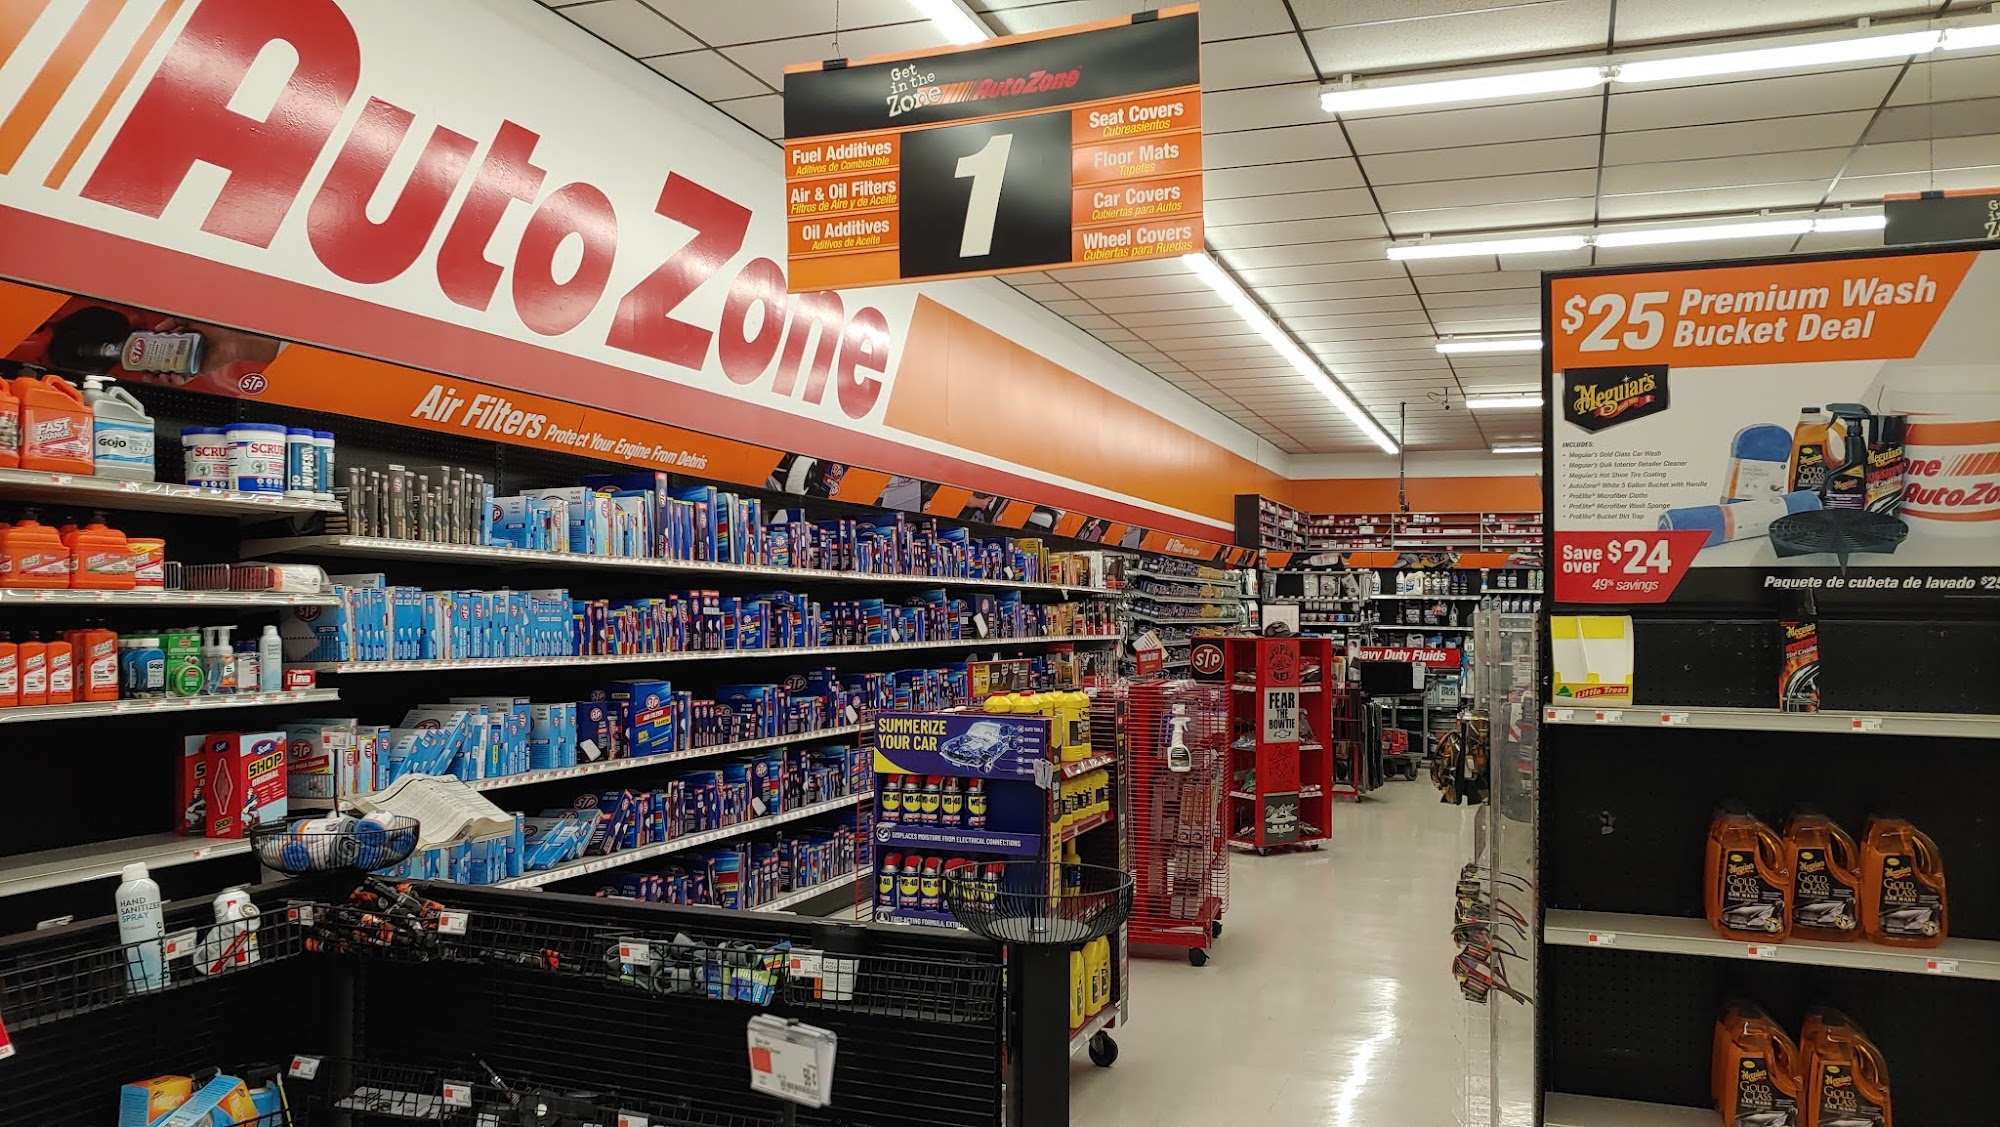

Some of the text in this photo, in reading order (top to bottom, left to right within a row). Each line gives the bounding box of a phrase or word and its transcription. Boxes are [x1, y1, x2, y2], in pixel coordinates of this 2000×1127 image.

[891, 63, 917, 81] Get
[890, 72, 935, 94] in the
[974, 69, 1080, 100] AutoZone
[886, 87, 942, 117] Zone
[1089, 102, 1184, 128] Seat Covers
[1103, 119, 1171, 138] Cubreasientos
[792, 141, 892, 165] Fuel Additives
[1094, 143, 1179, 168] Floor Mats
[796, 156, 890, 176] Aditivos de Combustible
[1119, 162, 1156, 176] Tapetes
[790, 180, 896, 204] Air & Oil Filters
[954, 134, 1013, 258] 1
[1093, 186, 1181, 209] Car Covers
[79, 0, 888, 419] AutoZone
[791, 193, 896, 214] Filtros de Aire y de Aceite
[1092, 201, 1182, 220] Cubiertas para Autos
[802, 219, 890, 241] Oil Additives
[812, 235, 881, 251] Aditivos de Aceite
[1082, 226, 1192, 250] Wheel Covers
[1083, 240, 1193, 261] Cubiertas para Ruedas
[1561, 274, 1937, 352] $25 Premium Wash
[1673, 310, 1876, 348] Bucket Deal
[241, 376, 264, 391] STP
[1573, 372, 1656, 417] Meguiar's
[38, 417, 71, 432] FAST
[410, 384, 708, 470] Air Filters Protect Your Engine From Debris
[99, 437, 127, 448] GOJO
[195, 446, 228, 457] SCRU
[1798, 465, 1824, 475] GOLD
[1901, 457, 1942, 477] one
[1643, 471, 1667, 479] Coating
[1801, 473, 1826, 481] CLASS
[1903, 482, 2000, 506] AutoZo
[1647, 502, 1671, 510] Sponge
[1563, 539, 1672, 575] Save $24
[1563, 561, 1600, 575] over
[1591, 578, 1659, 593] 49% savings
[1764, 576, 1823, 589] Paquete
[1826, 576, 1845, 589] de
[1848, 576, 1899, 589] cubeta
[1902, 576, 1922, 589] de
[1925, 576, 1976, 589] lavado
[1195, 648, 1220, 669] STP
[1360, 649, 1447, 662] eavy Duty Fluids
[292, 673, 311, 683] Lava
[787, 677, 804, 691] STP
[1576, 686, 1628, 698] Little Trees
[648, 696, 659, 709] STP
[1269, 692, 1295, 709] FEAR
[1276, 709, 1288, 719] THE
[878, 718, 947, 735] SUMMERIZE
[1269, 719, 1295, 730] BOWTIE
[293, 741, 311, 756] STP
[879, 734, 937, 751] YOUR CAR
[249, 752, 283, 778] SHOP
[252, 769, 280, 787] ORIGINAL
[576, 796, 596, 808] STP
[904, 795, 921, 803] WD-4
[943, 797, 961, 805] WD-40
[892, 831, 1021, 847] DISPLACES MOISTURE FROM ELECTRICAL CONNECTIONS
[901, 878, 939, 888] WD-40 WD-4
[1727, 874, 1757, 886] GOLD
[1798, 872, 1828, 884] GOLD
[1883, 878, 1914, 890] GOLD
[1730, 883, 1759, 894] CLASS
[1801, 881, 1830, 892] CLASS
[1886, 887, 1917, 898] CLASS
[120, 897, 146, 908] HAND
[122, 911, 149, 923] SPRAY
[1739, 1081, 1770, 1093] GOLD
[1823, 1086, 1855, 1100] GOLD
[1743, 1091, 1772, 1101] CLASS
[1827, 1097, 1858, 1108] CLASS
